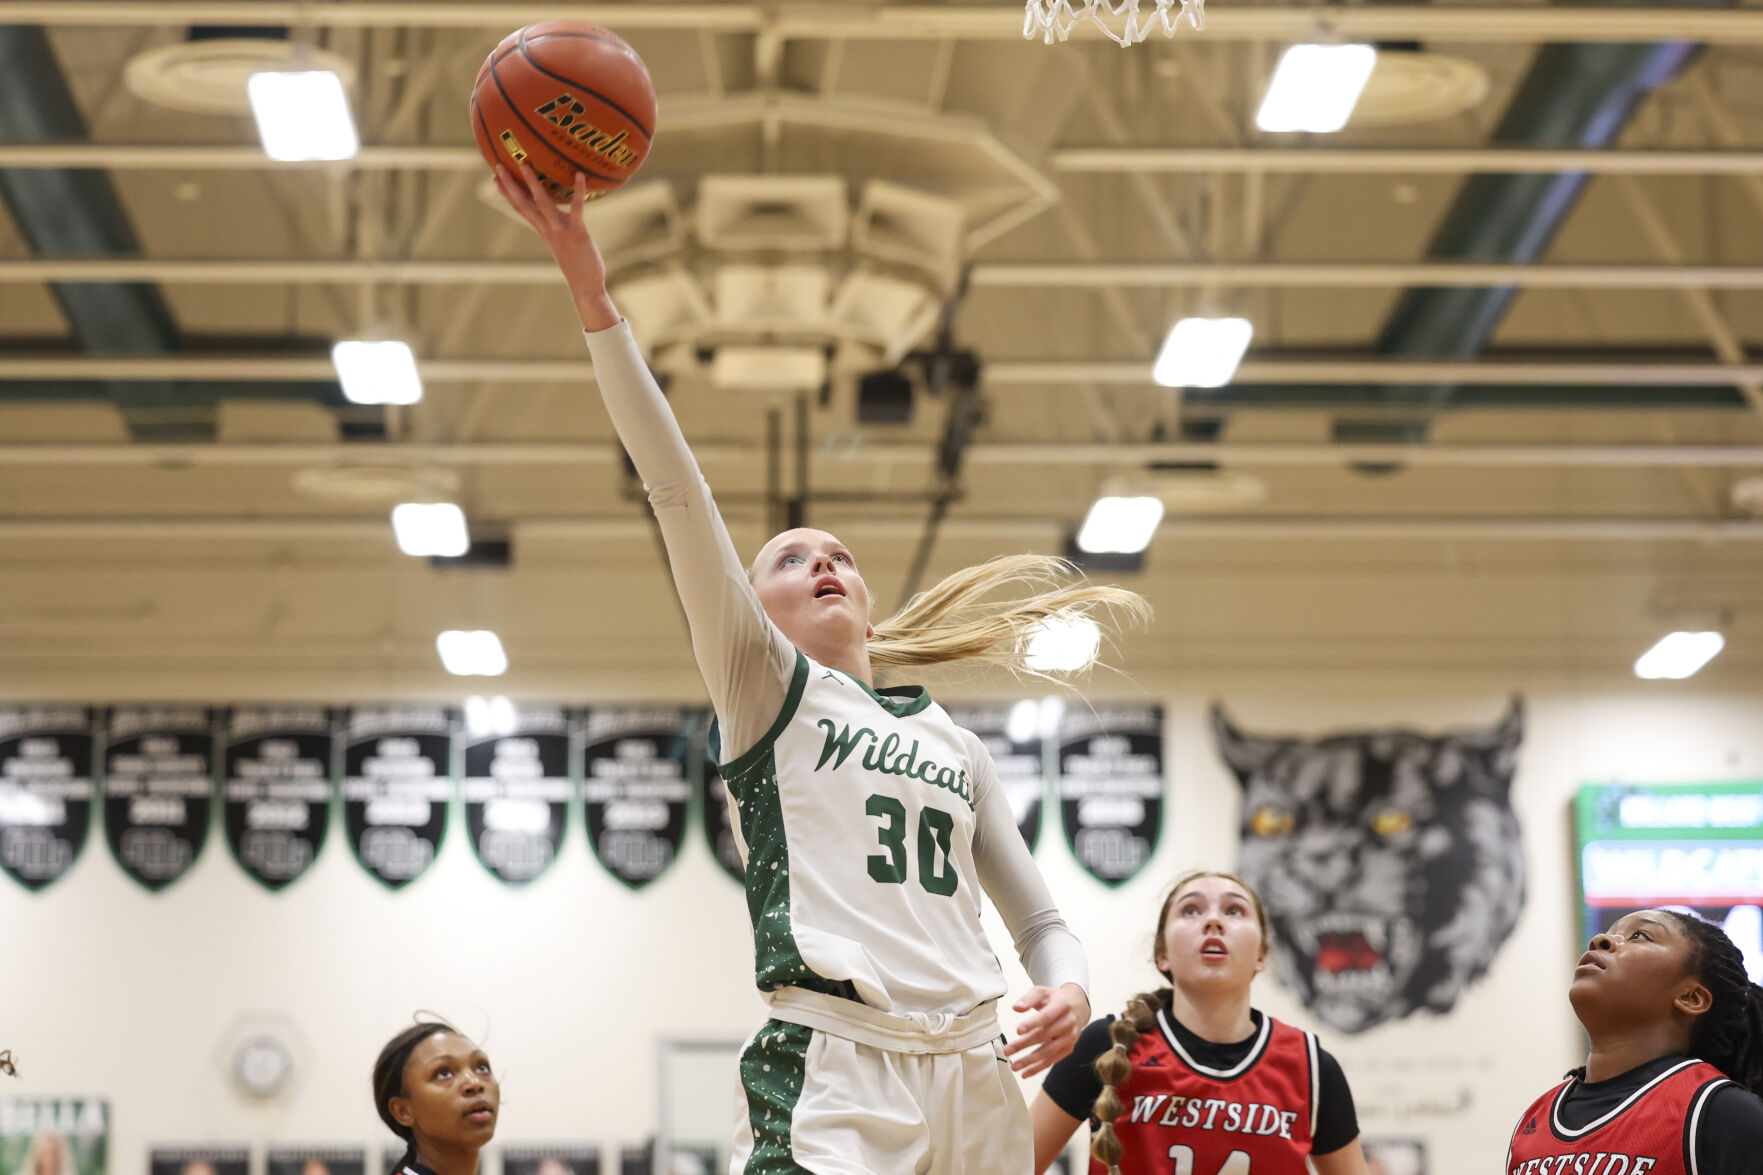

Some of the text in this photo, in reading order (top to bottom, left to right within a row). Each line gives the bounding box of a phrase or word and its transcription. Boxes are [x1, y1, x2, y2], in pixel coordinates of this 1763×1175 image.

[535, 93, 638, 169] Baden
[866, 793, 958, 897] 30
[1131, 1094, 1298, 1140] WESTSIDE
